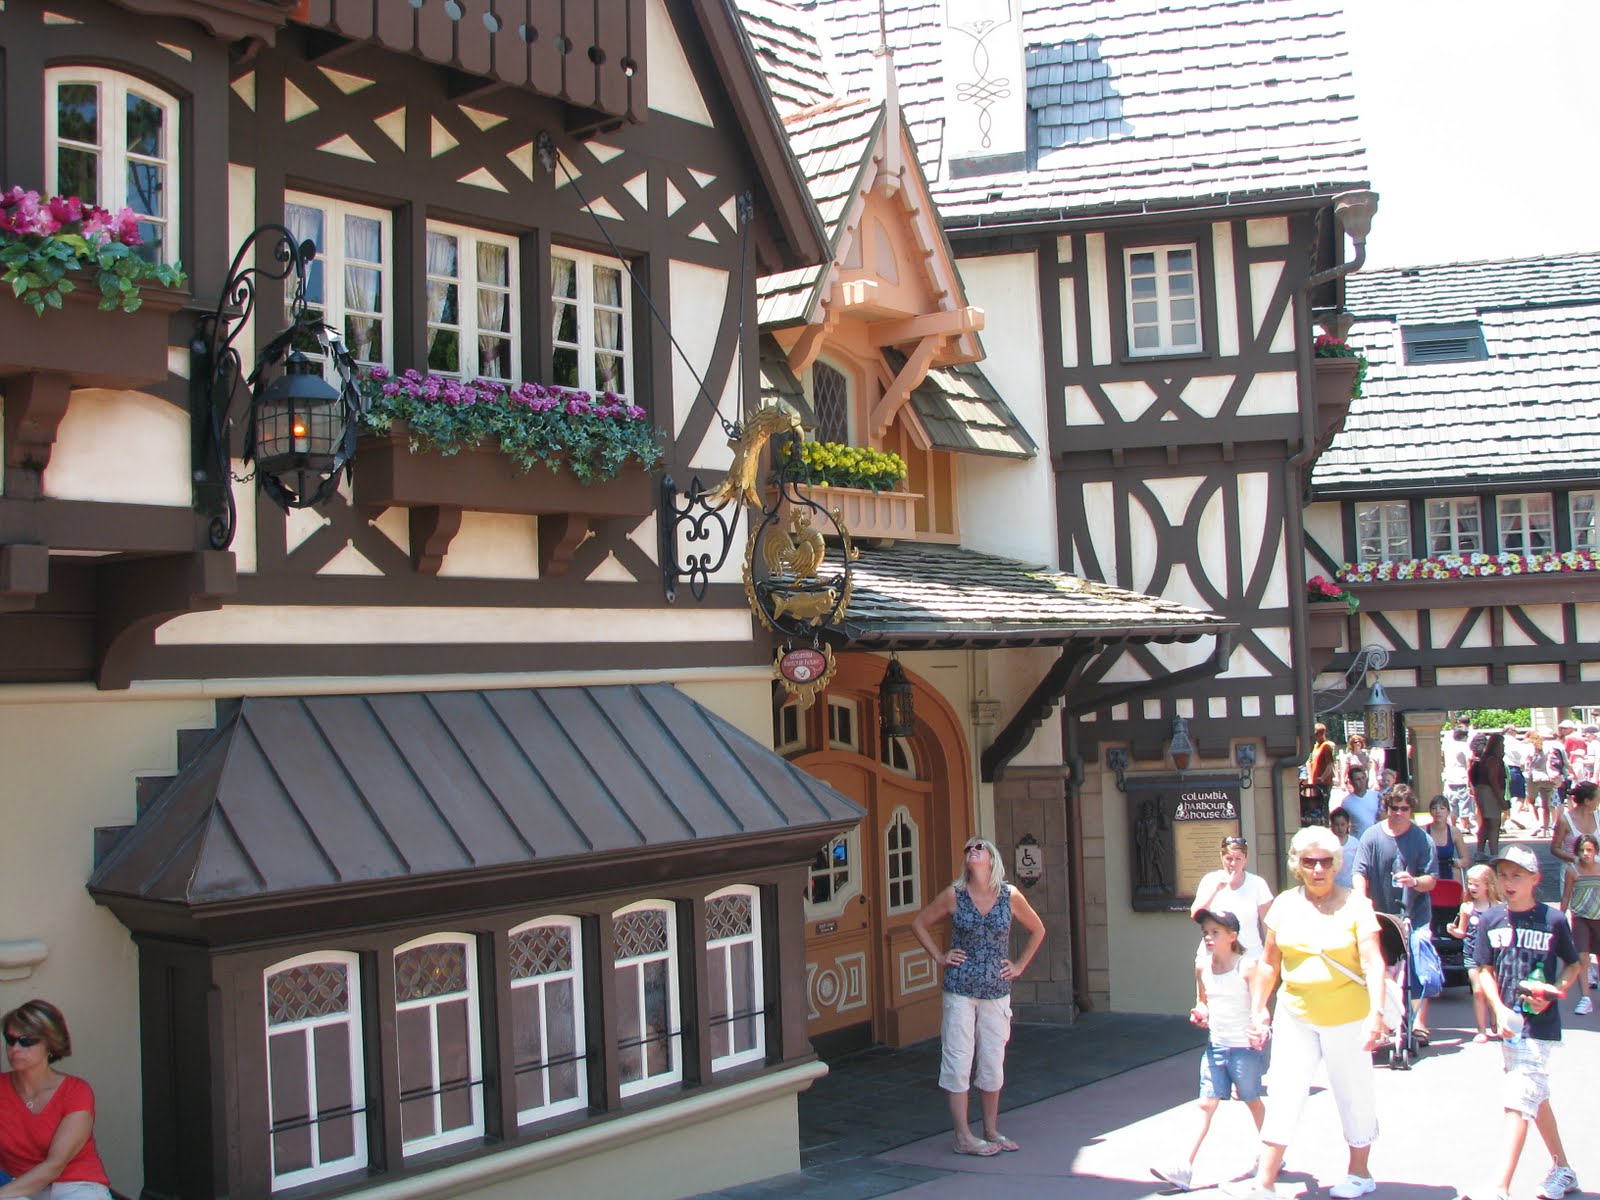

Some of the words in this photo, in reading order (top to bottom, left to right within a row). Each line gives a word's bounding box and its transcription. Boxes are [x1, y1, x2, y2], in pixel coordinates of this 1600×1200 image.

[1181, 791, 1228, 801] COLUMBIA
[1184, 801, 1226, 811] HARBOUR
[1190, 811, 1220, 819] HOUSE
[1515, 928, 1554, 951] YORK
